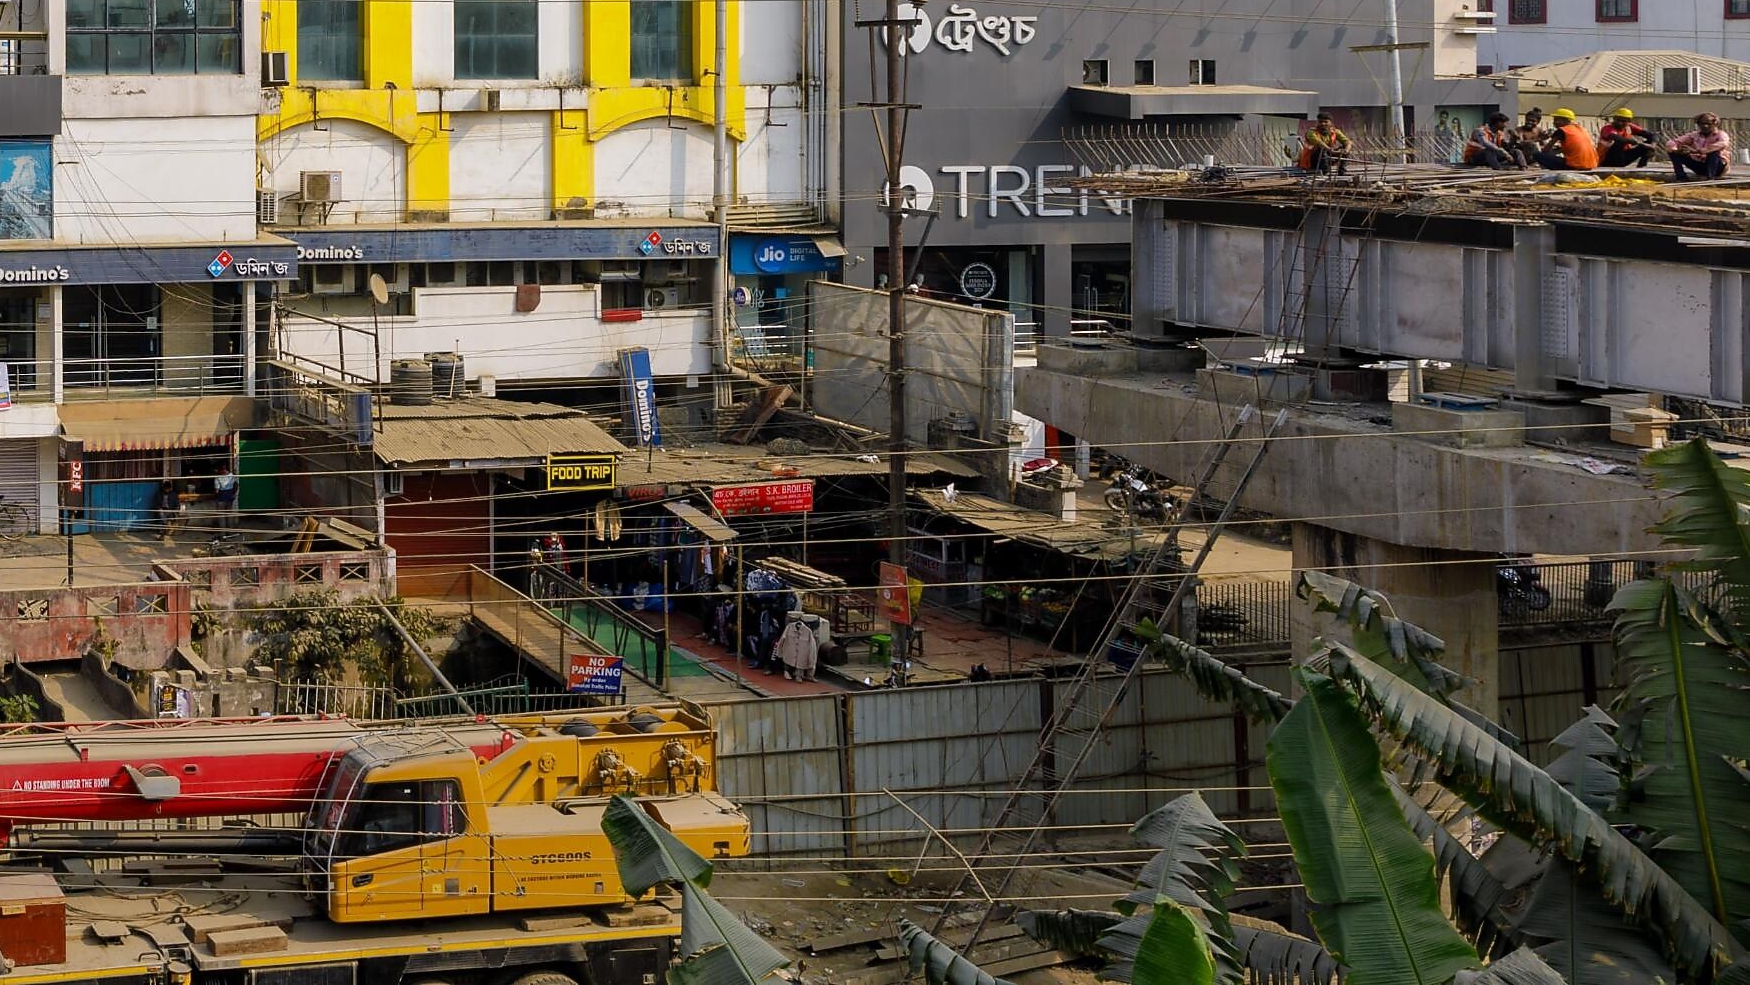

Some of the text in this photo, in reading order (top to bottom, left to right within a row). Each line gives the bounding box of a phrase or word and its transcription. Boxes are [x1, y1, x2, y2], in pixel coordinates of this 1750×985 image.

[297, 245, 363, 259] Domino's
[759, 246, 785, 262] Jio
[635, 380, 652, 441] Domino's
[71, 462, 82, 492] KFC
[552, 466, 611, 480] FOOD TRIP
[627, 486, 664, 498] VIRUS
[766, 483, 812, 495] S.K. BROILER
[589, 657, 606, 666] NO
[571, 665, 620, 677] PARKING
[23, 778, 110, 790] NO STANDING UNDER THE BOOM
